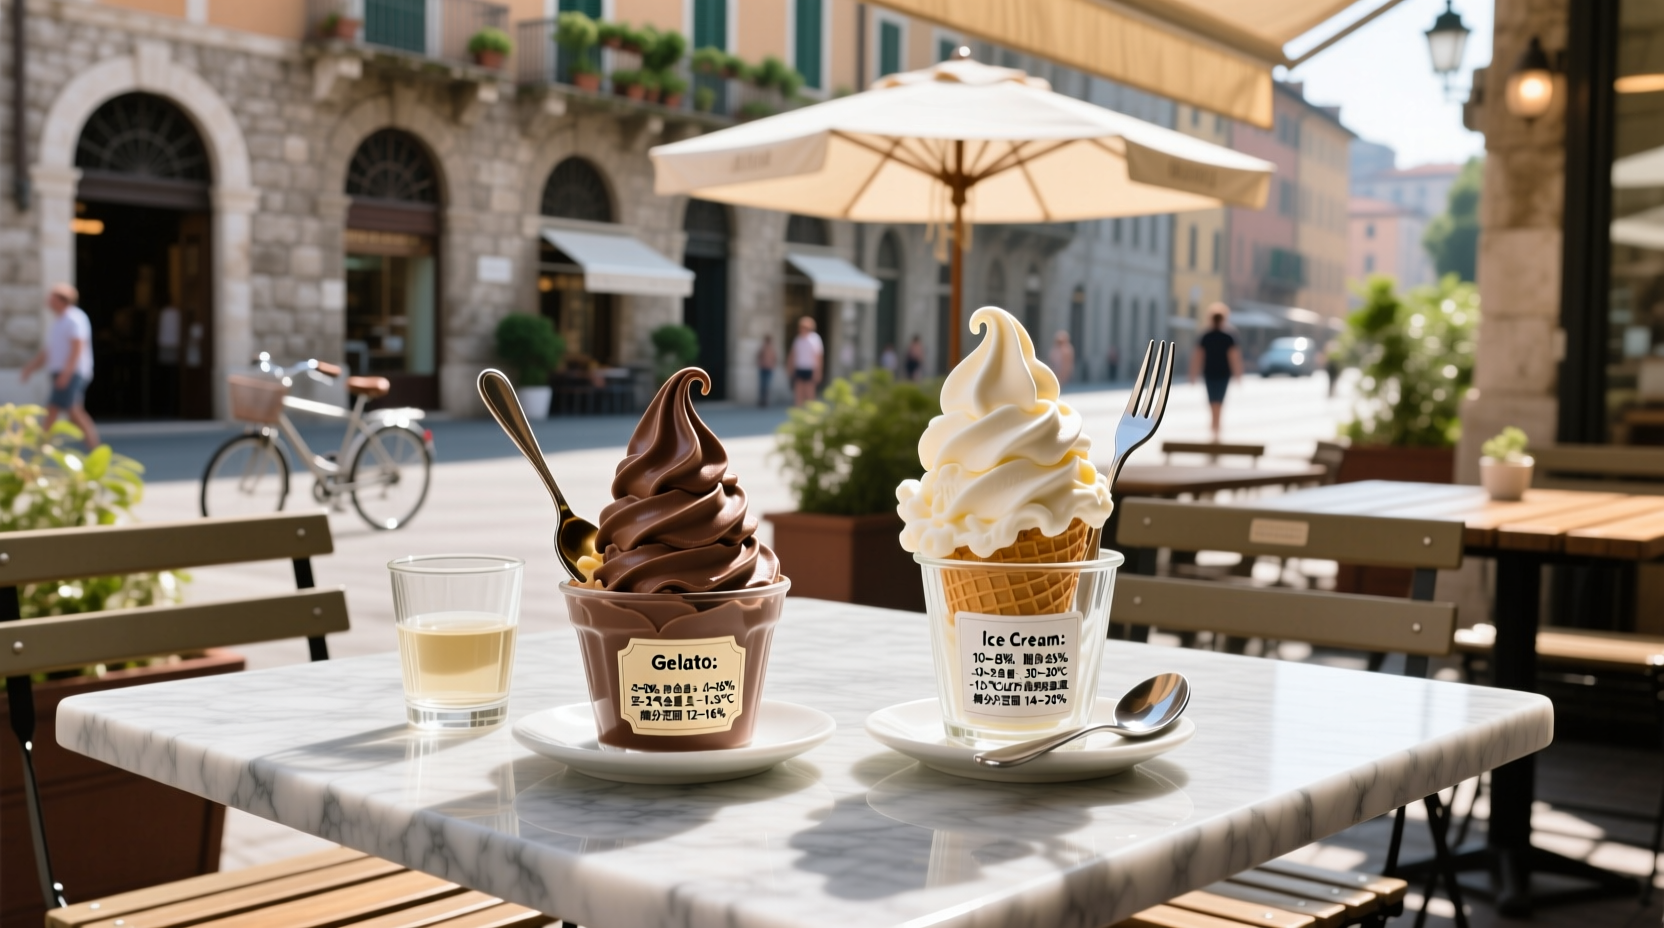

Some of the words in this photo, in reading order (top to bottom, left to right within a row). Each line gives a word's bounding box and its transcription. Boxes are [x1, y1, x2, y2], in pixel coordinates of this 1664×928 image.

[982, 630, 1005, 647] Ice
[1009, 631, 1066, 647] Cream:
[651, 653, 718, 671] Gelato:
